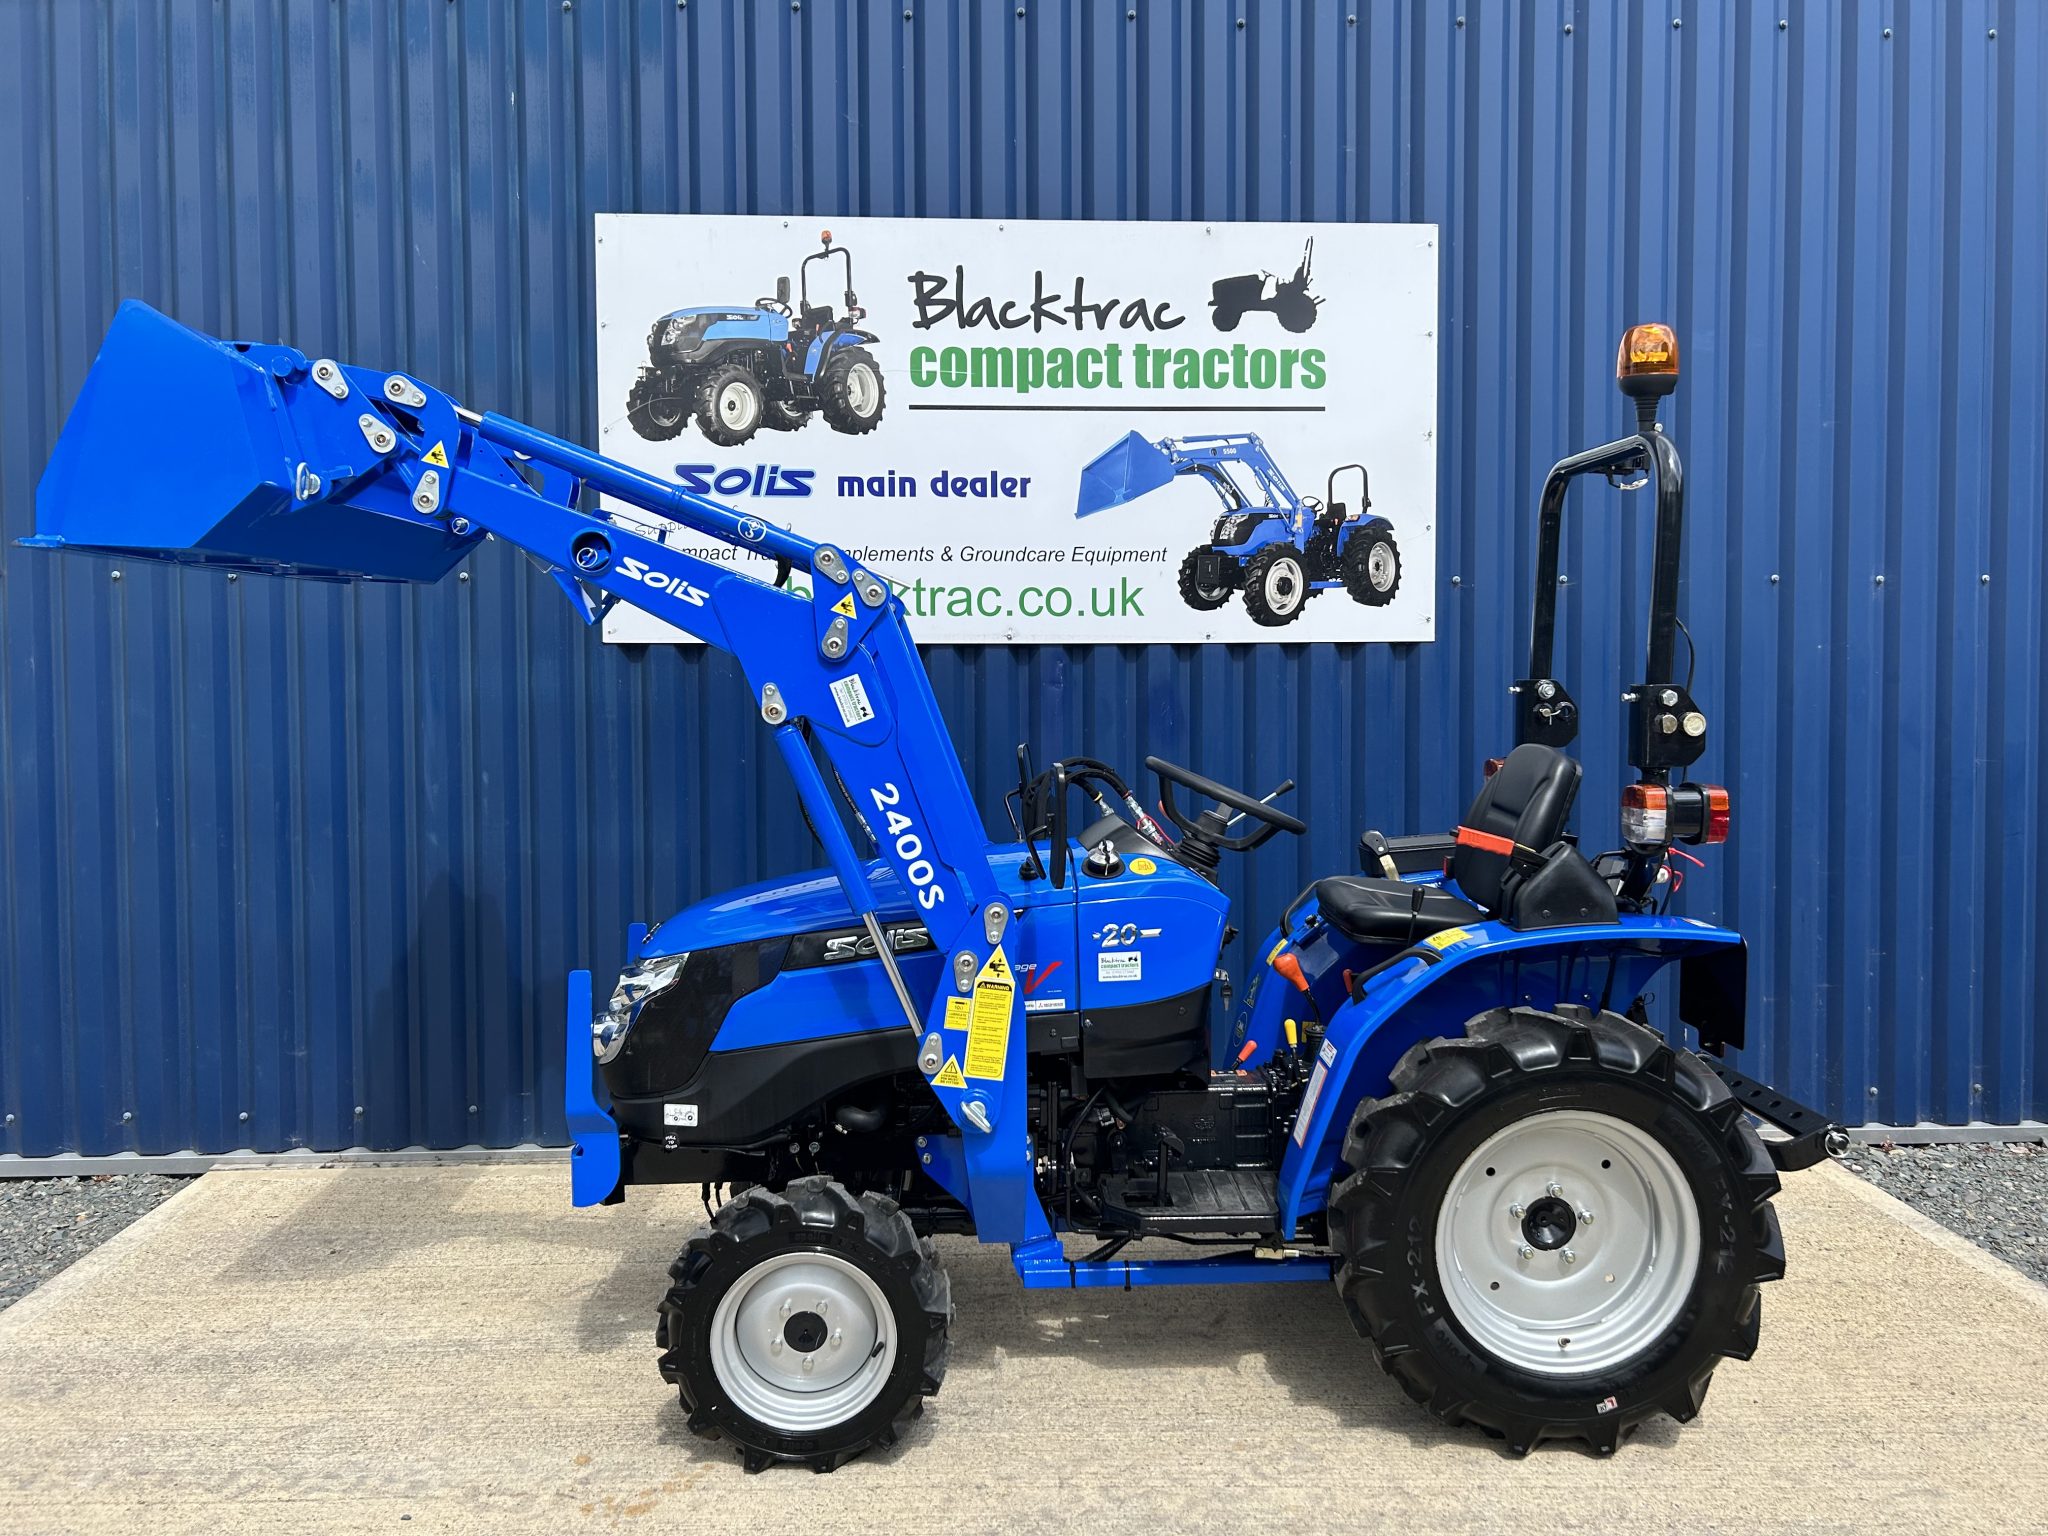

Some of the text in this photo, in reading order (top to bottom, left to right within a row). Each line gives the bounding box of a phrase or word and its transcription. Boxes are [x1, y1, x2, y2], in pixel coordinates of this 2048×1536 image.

[907, 264, 1186, 333] Blacktrac
[909, 343, 1327, 393] compact tractors
[837, 470, 1032, 498] main dealer
[615, 556, 710, 607] Solis
[940, 547, 953, 562] &
[960, 547, 1065, 563] Groundcare
[1071, 547, 1168, 567] Equipment
[870, 782, 945, 910] 2400S
[986, 983, 1010, 991] WARNING
